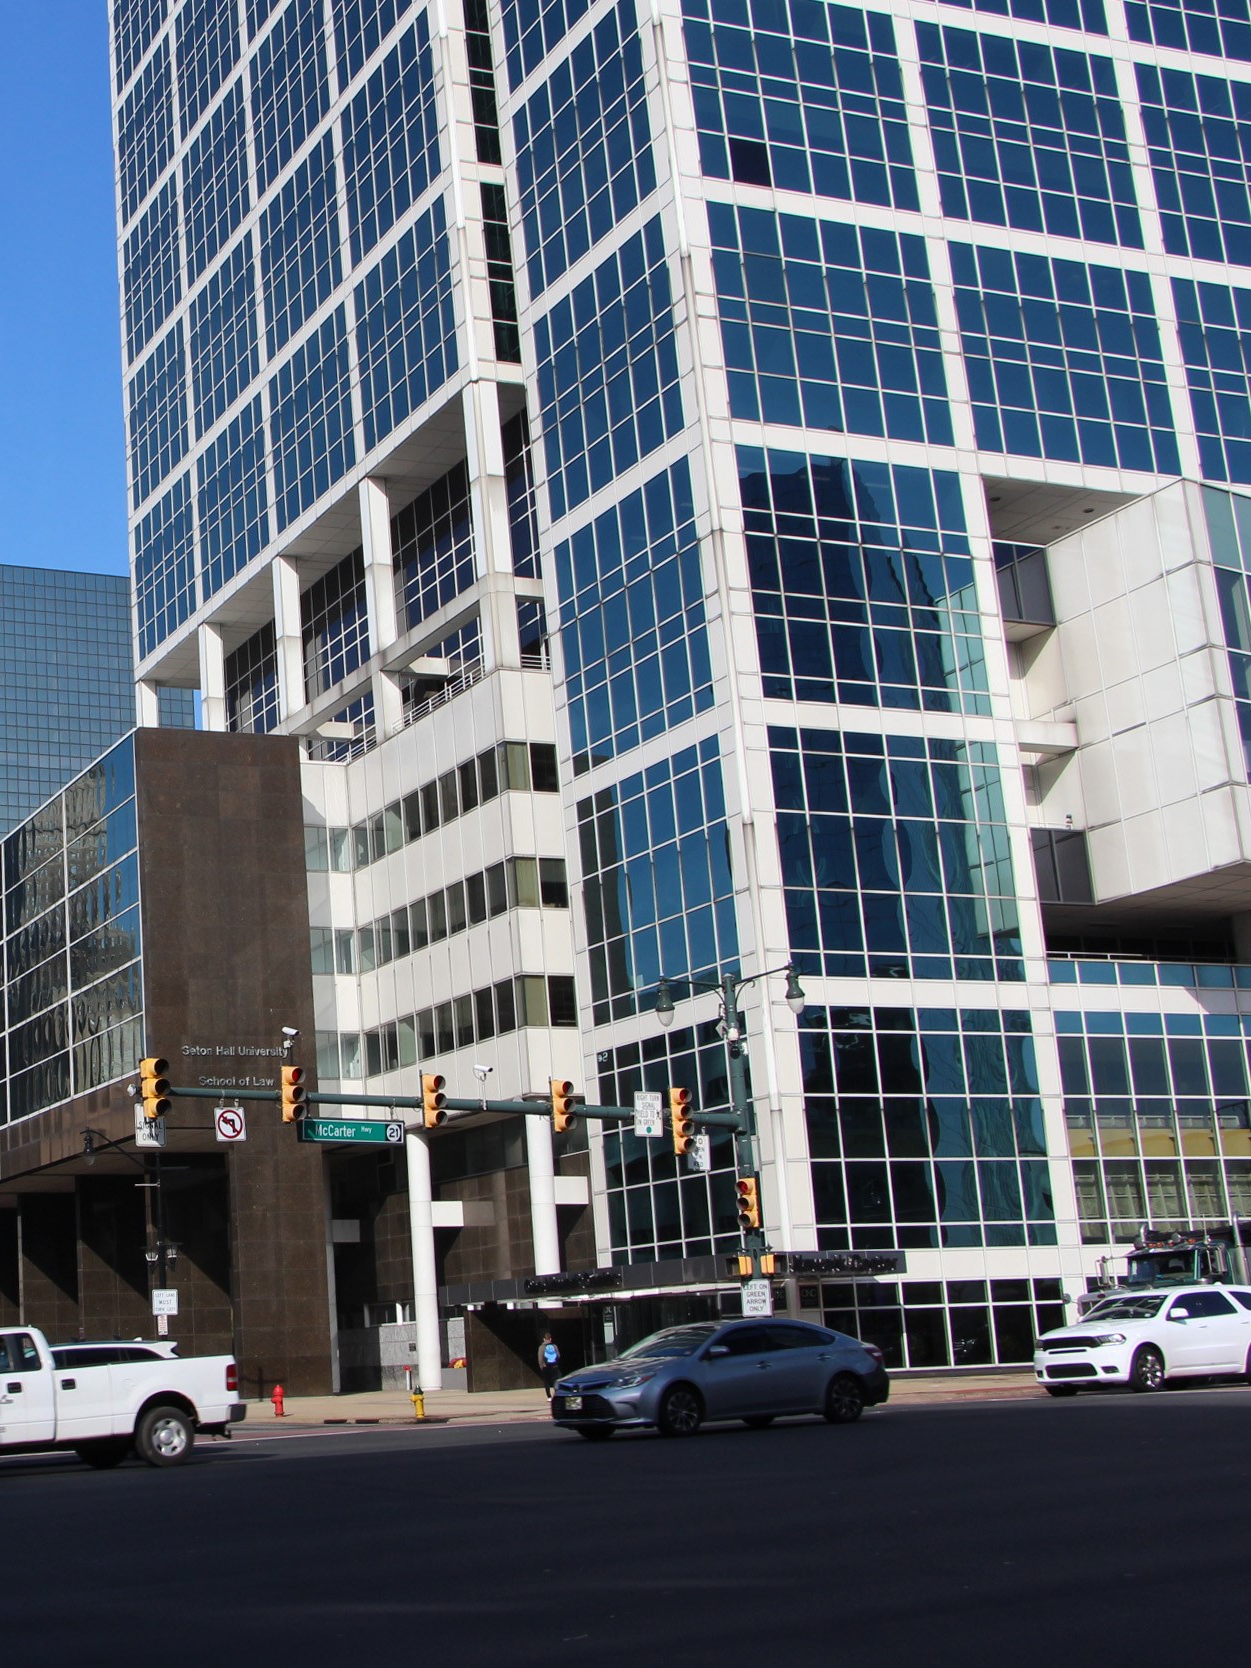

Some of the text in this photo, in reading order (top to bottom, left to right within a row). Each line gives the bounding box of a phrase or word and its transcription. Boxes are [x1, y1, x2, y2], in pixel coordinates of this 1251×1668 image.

[181, 1045, 288, 1058] Seton Hall University
[199, 1076, 274, 1086] School of Law
[641, 1102, 655, 1110] SIGNAL
[315, 1124, 372, 1137] McCarter Hwy
[389, 1128, 398, 1138] 21
